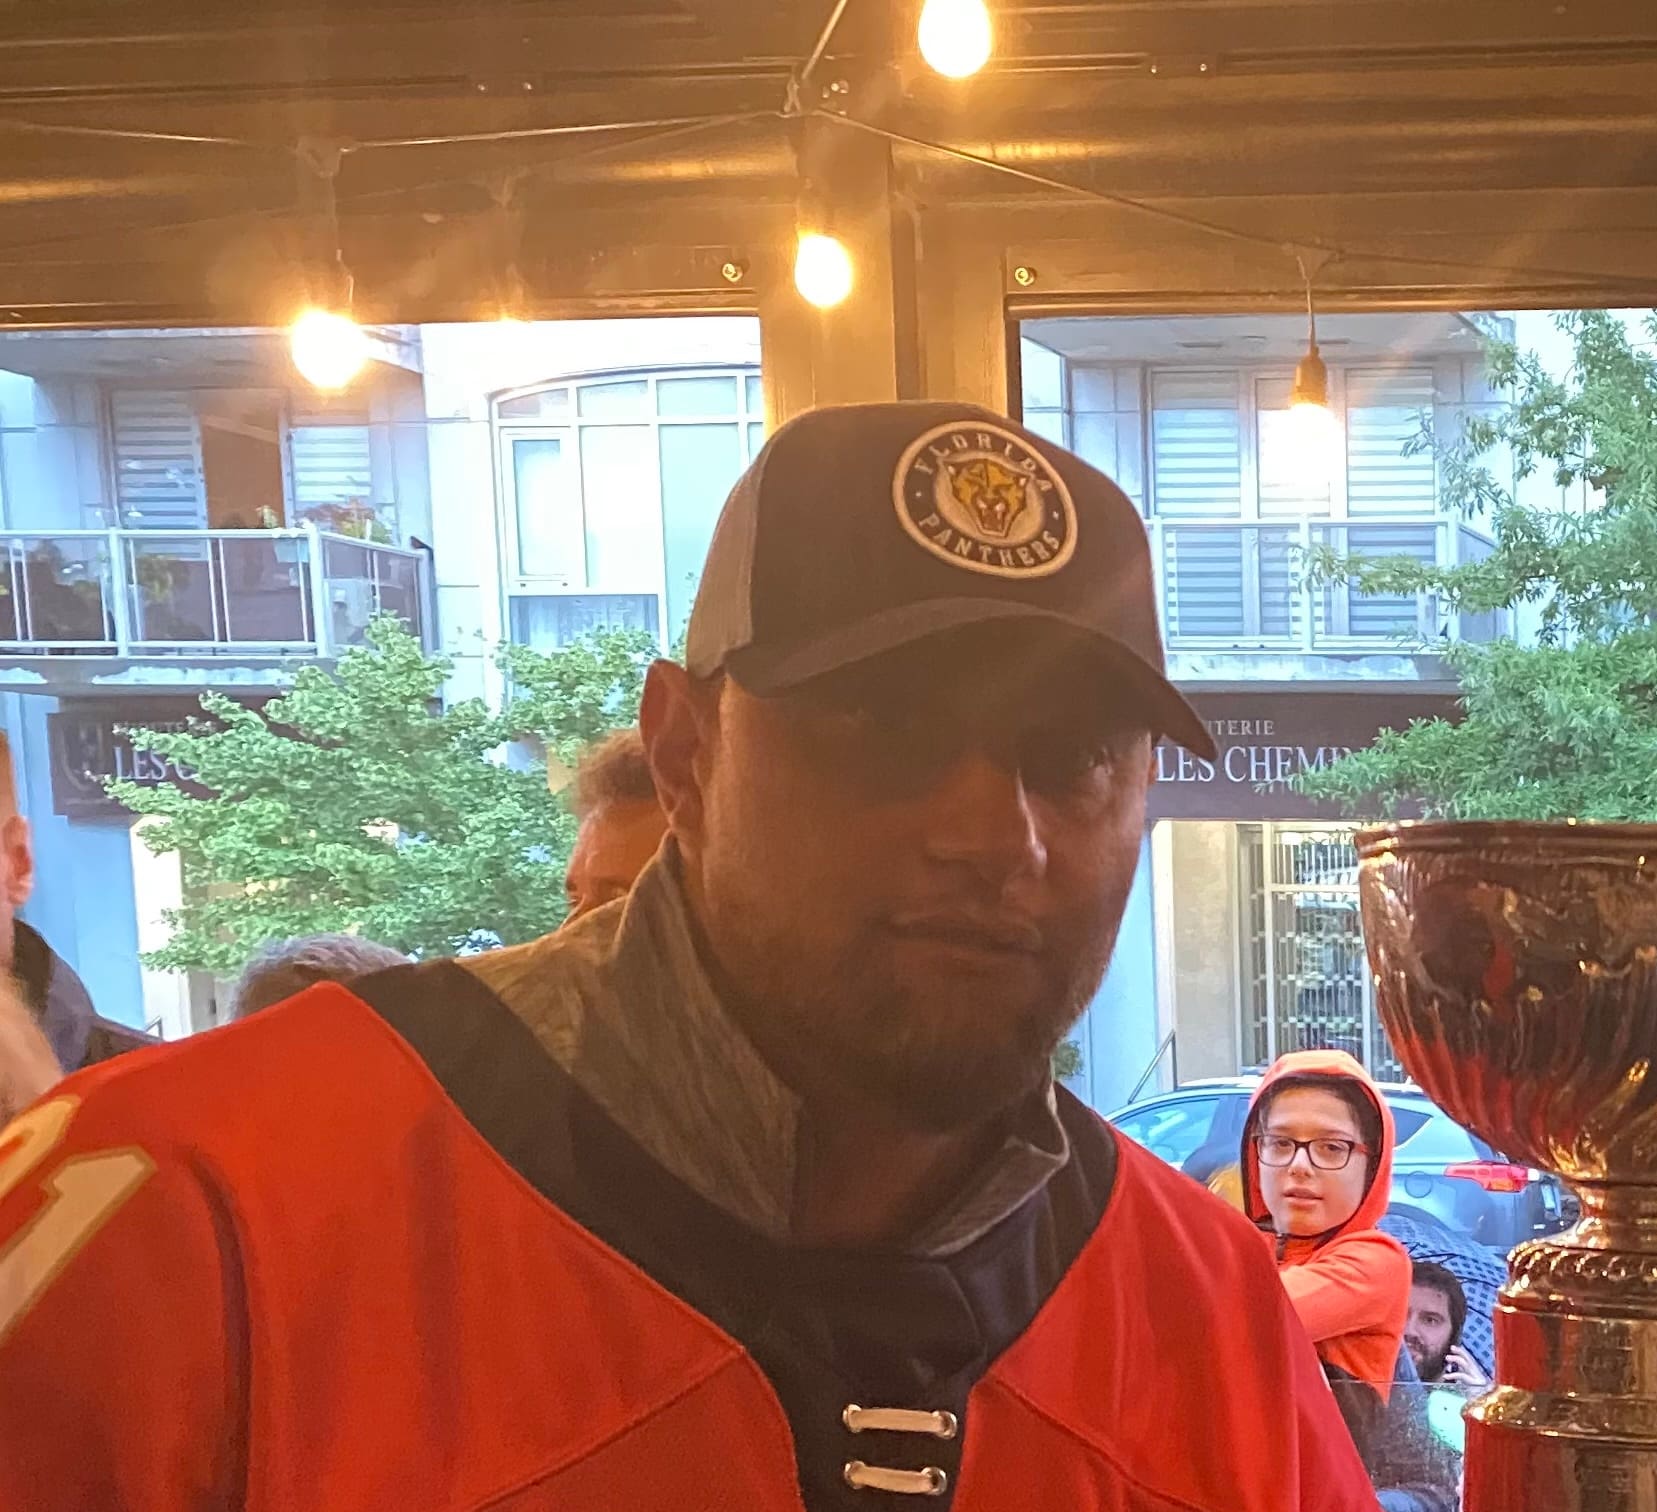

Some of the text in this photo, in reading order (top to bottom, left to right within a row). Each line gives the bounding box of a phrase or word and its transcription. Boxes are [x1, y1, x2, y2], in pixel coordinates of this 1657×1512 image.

[914, 432, 1053, 493] FLORIDA
[919, 511, 1060, 567] PANTHERS
[1155, 745, 1215, 783] LES
